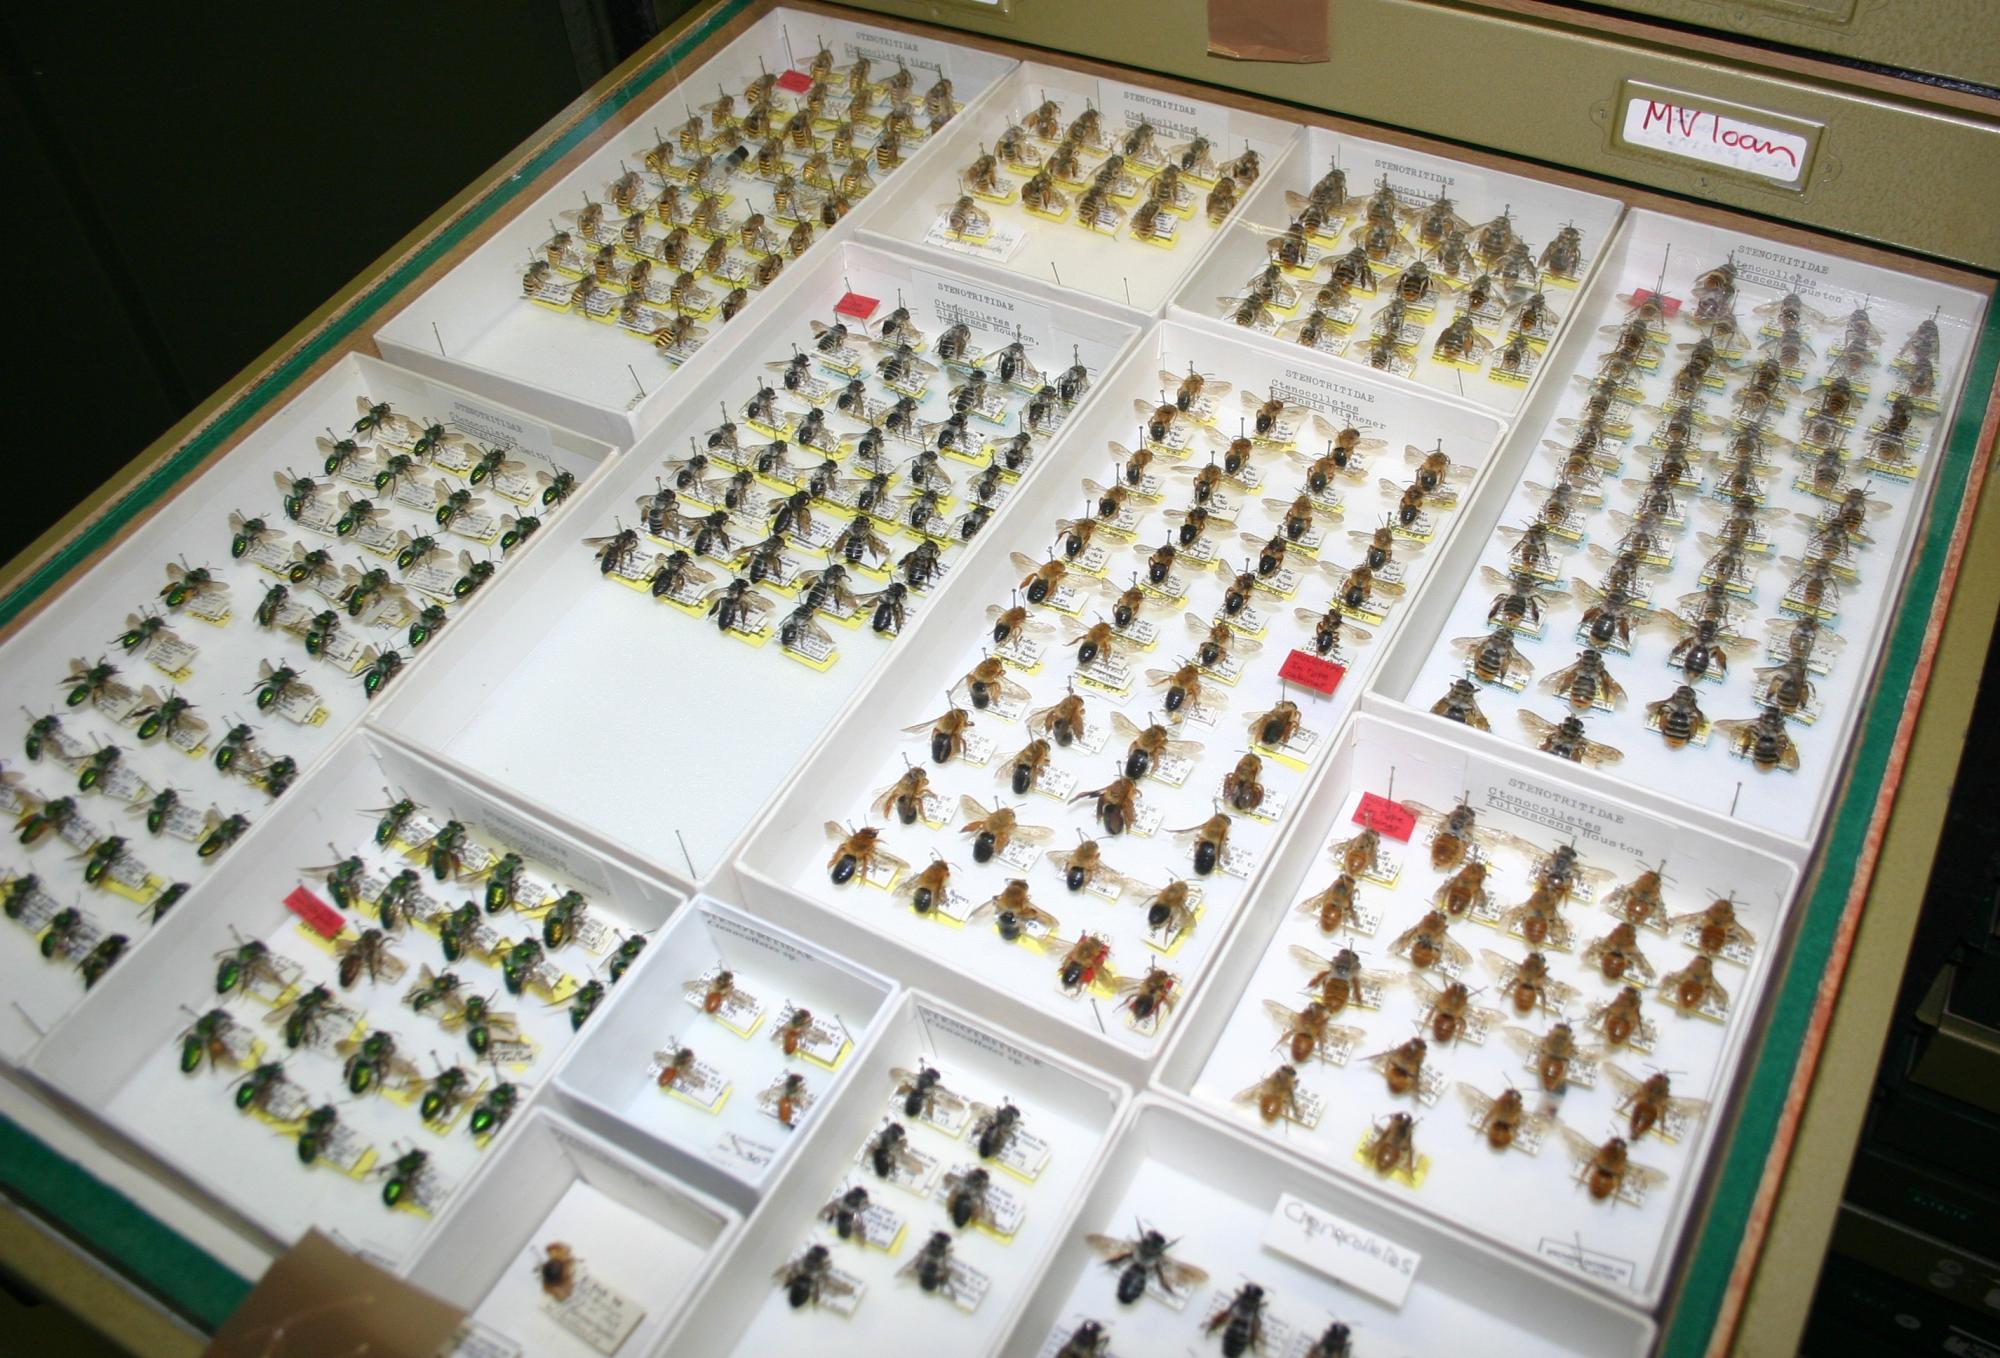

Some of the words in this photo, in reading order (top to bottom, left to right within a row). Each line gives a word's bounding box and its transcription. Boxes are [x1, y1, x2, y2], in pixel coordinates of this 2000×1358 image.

[1123, 91, 1196, 115] STENOTRITIDAE
[1643, 101, 1700, 137] MV
[1712, 115, 1796, 168] loan
[1374, 159, 1455, 186] STENOTRITIDAE
[1736, 260, 1817, 287] tenocolletes
[1737, 244, 1830, 275] STENOTRITIDAE
[937, 282, 1014, 311] STENOTRITIDAE
[1797, 285, 1842, 304] ouston
[1271, 379, 1360, 413] Ctenocolletes
[1271, 389, 1326, 411] ordensis
[1285, 369, 1375, 403] STENOTRITIDAE
[1488, 786, 1603, 832] Ctenocolletes
[1508, 777, 1625, 825] STENOTRITIDAE
[1487, 795, 1574, 832] fulvescens
[1582, 828, 1644, 858] Houston
